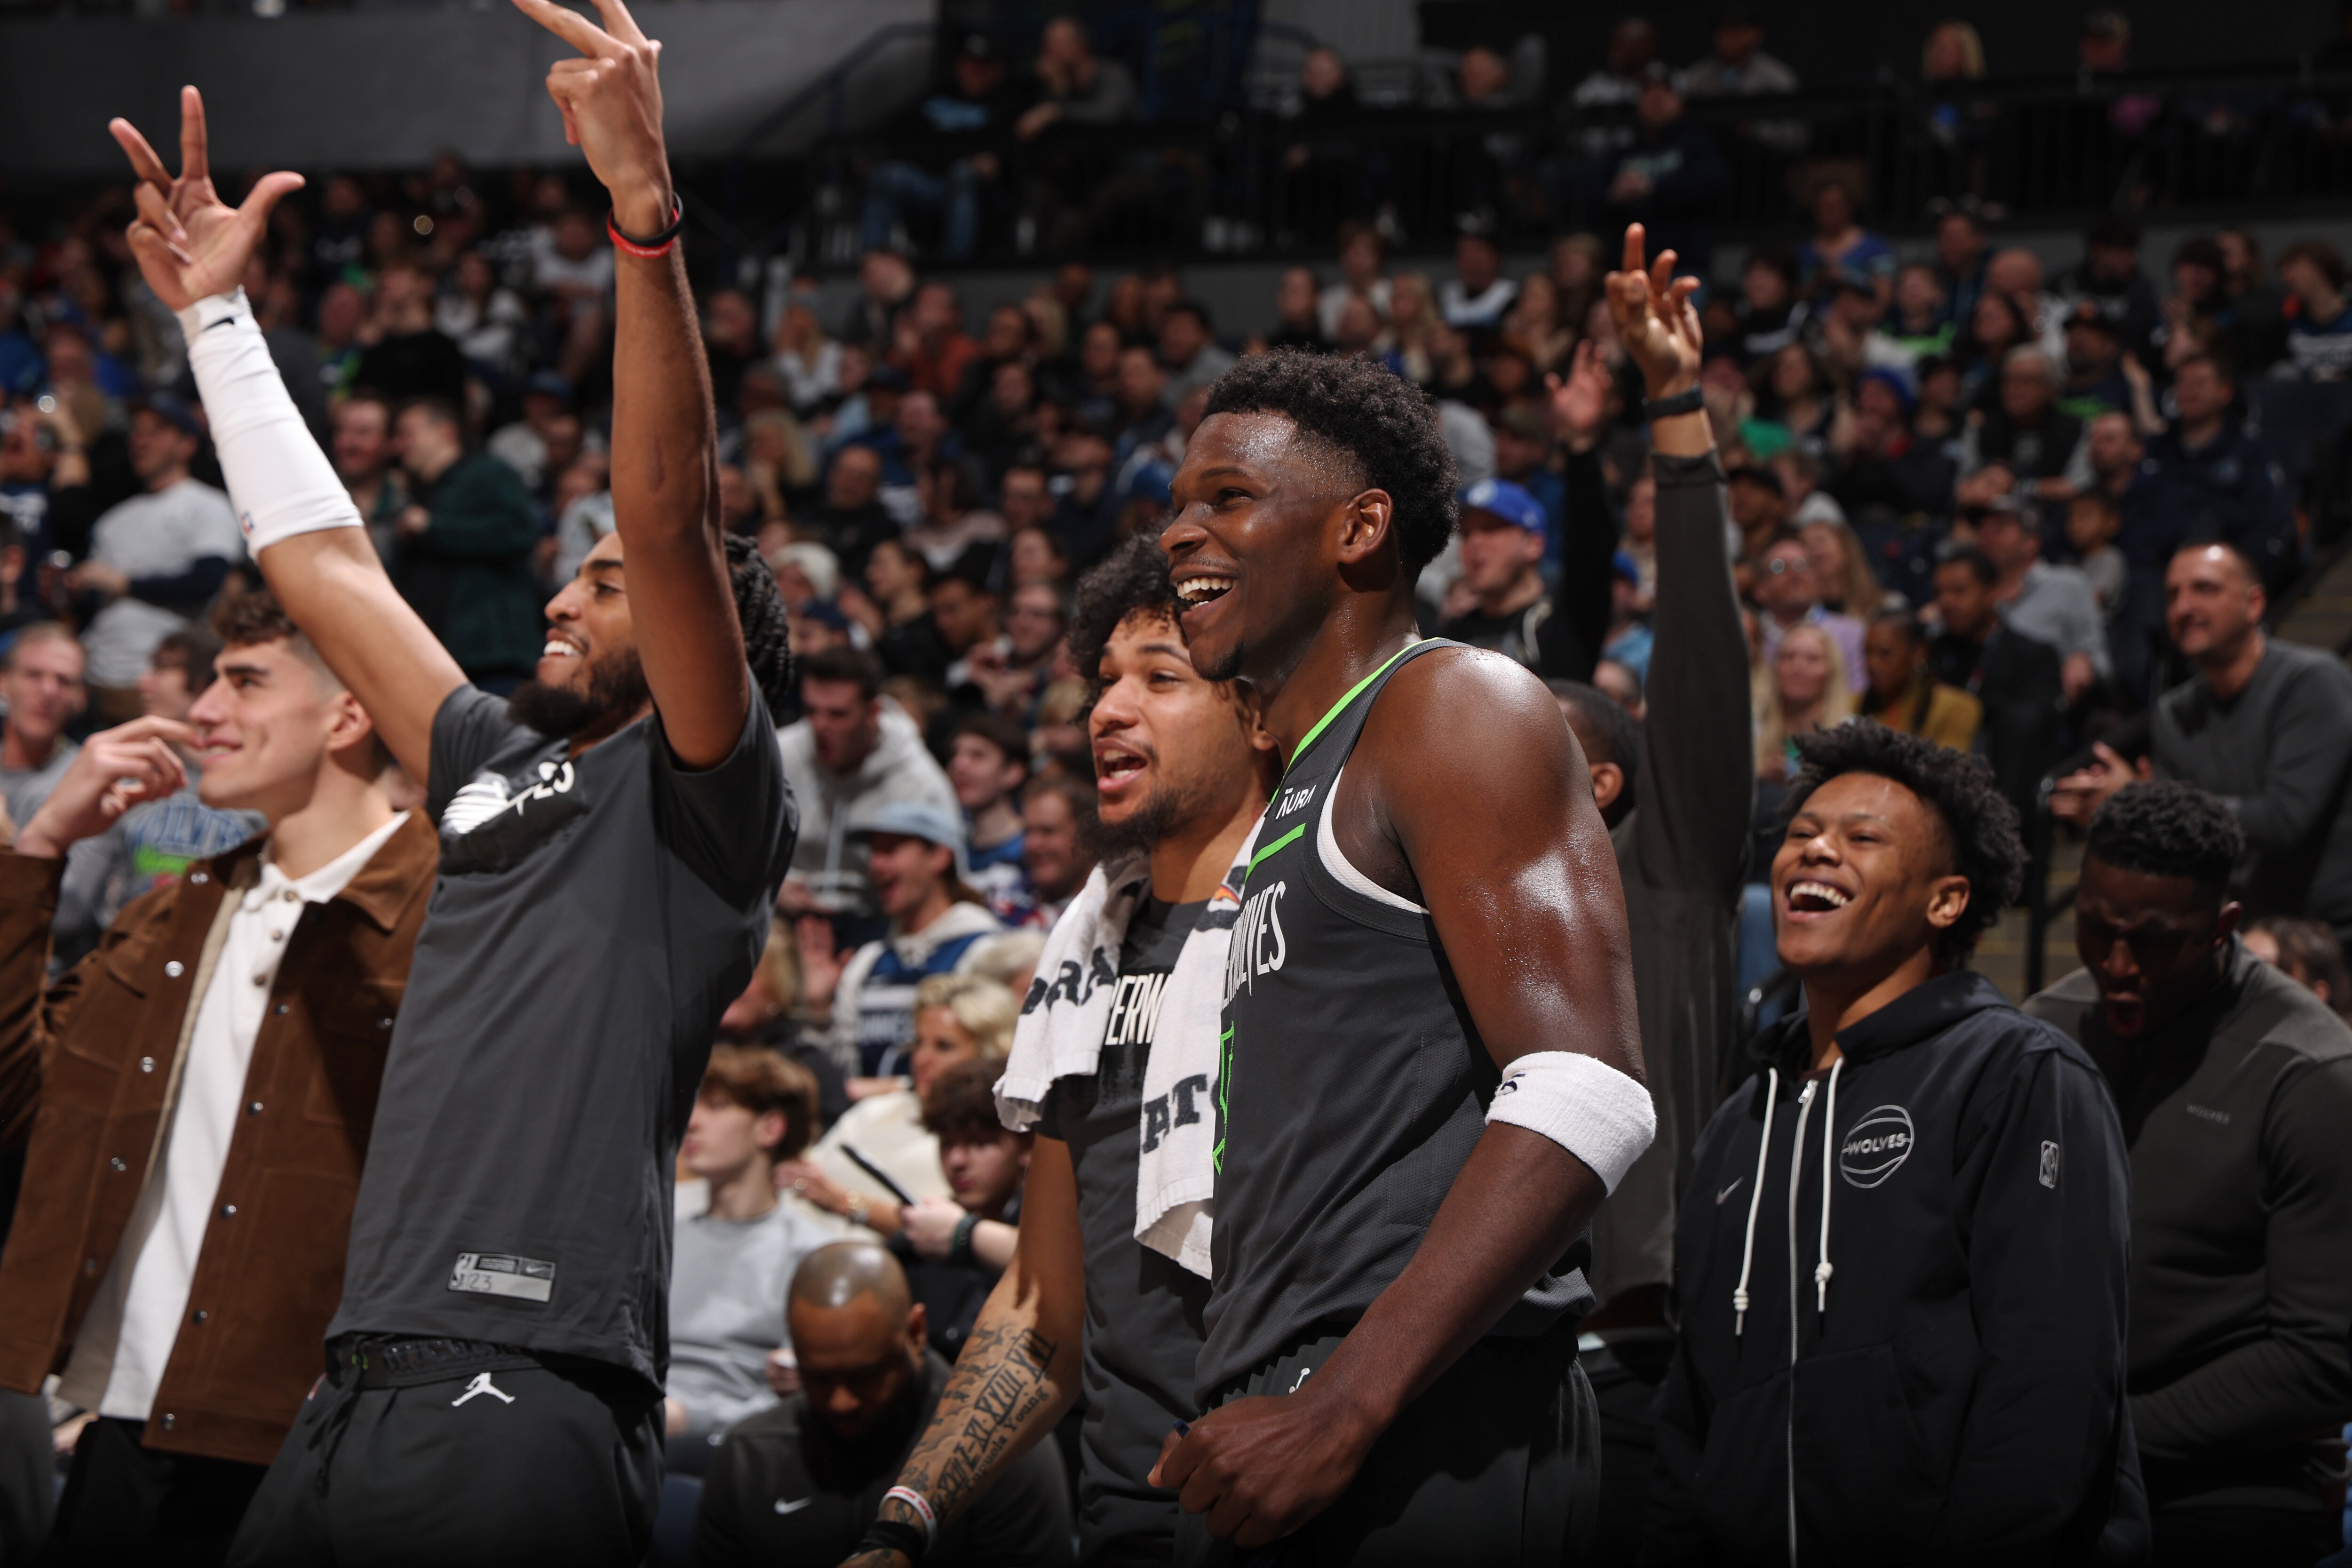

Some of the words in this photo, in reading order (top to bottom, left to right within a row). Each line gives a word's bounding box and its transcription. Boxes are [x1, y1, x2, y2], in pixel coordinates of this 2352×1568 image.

[2186, 1102, 2231, 1125] WOLVES
[1847, 1132, 1907, 1156] WOLVES
[1004, 1387, 1048, 1431] Young
